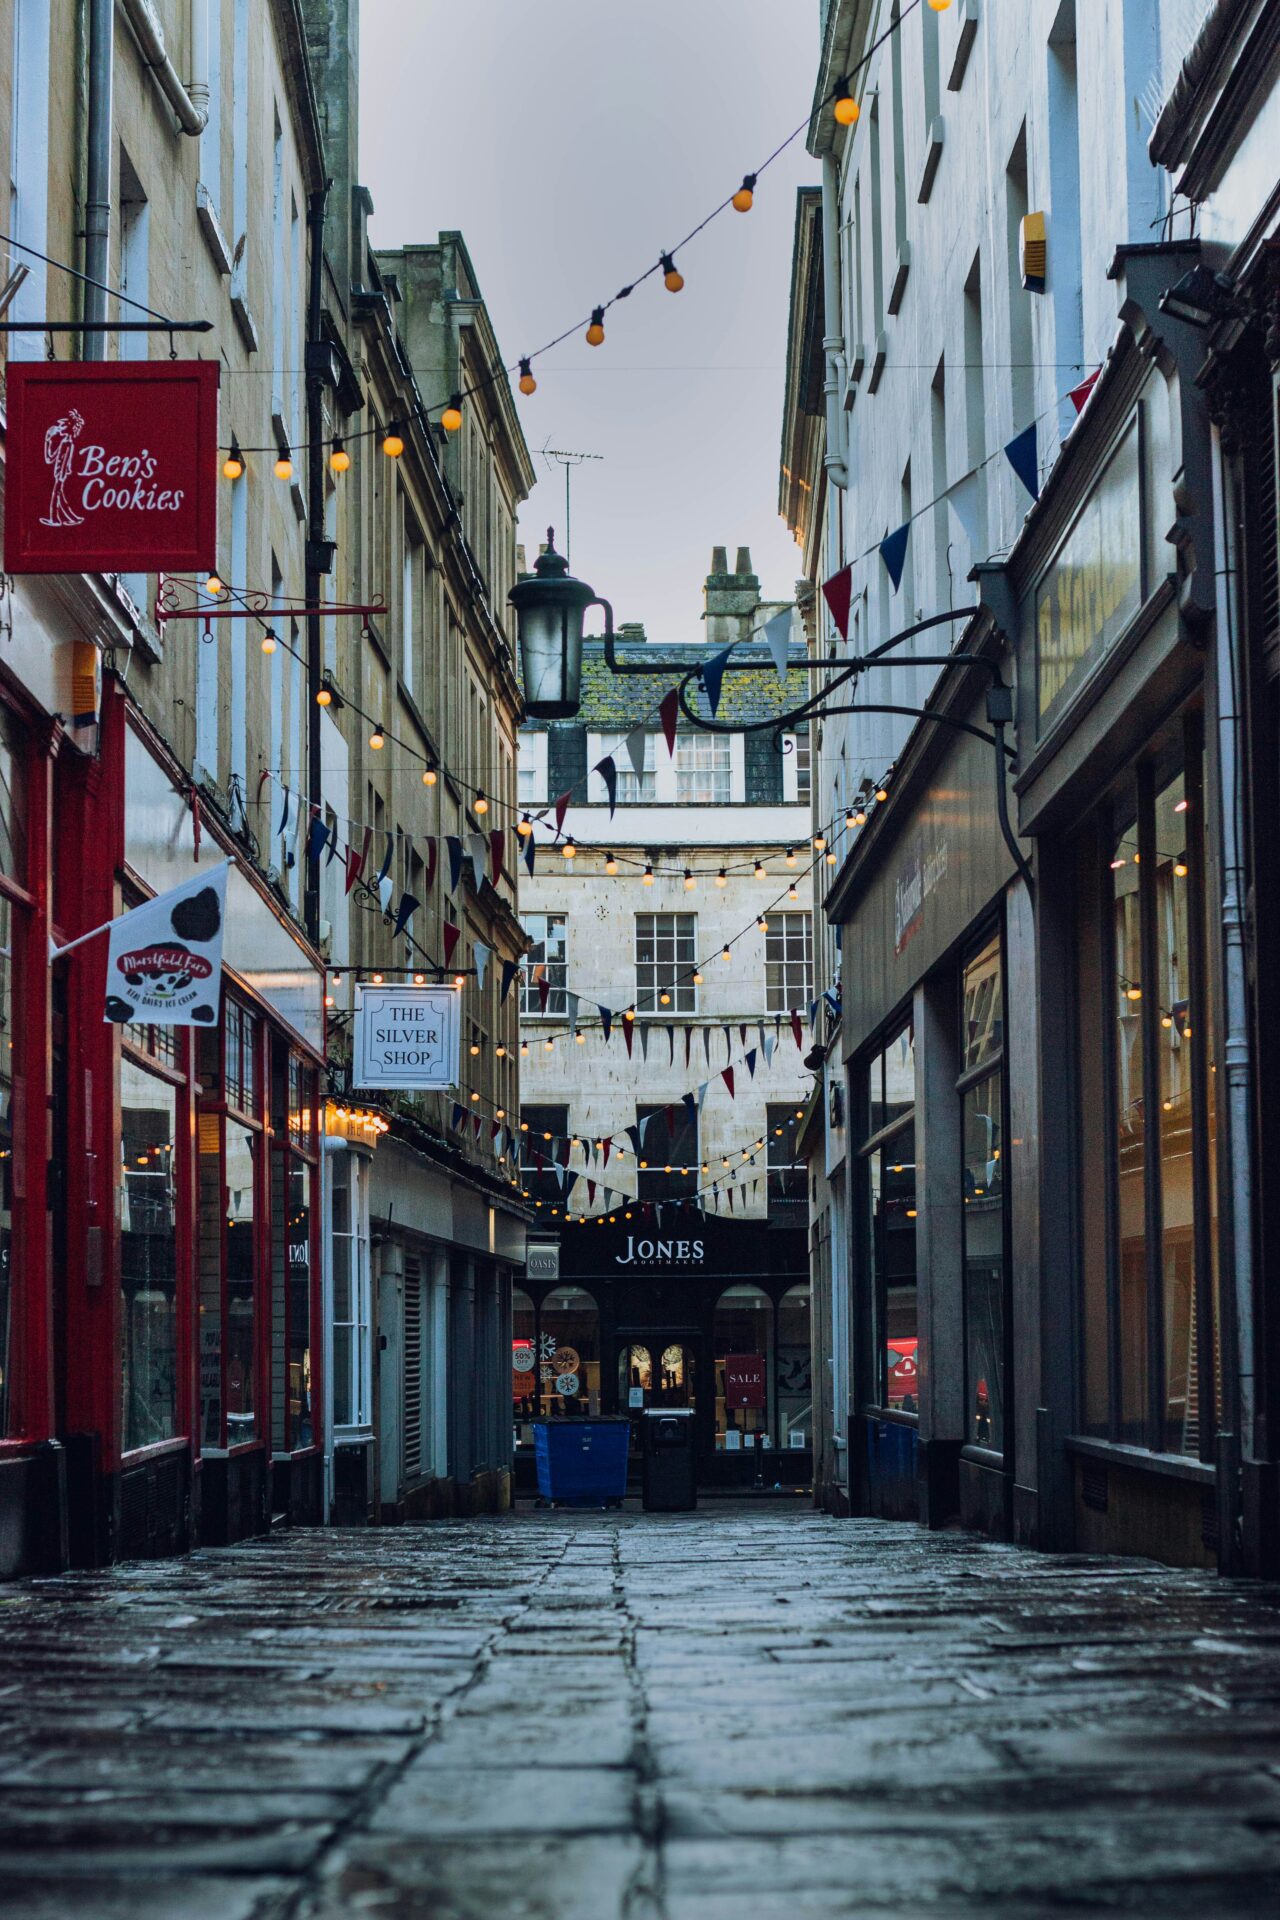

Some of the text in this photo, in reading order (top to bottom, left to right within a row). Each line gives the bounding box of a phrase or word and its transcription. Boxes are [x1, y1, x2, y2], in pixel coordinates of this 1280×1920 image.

[78, 445, 158, 478] Ben's
[82, 478, 185, 511] Cookies
[123, 952, 208, 974] Marshfield Farm
[126, 988, 140, 1001] REAL
[165, 999, 176, 1008] ICE
[178, 990, 198, 1006] CREAM
[389, 1007, 425, 1022] THE
[376, 1029, 438, 1043] SILVER
[383, 1051, 430, 1065] SHOP
[615, 1236, 704, 1264] JONES
[530, 1259, 556, 1269] OASIS
[515, 1352, 531, 1360] 50%
[729, 1373, 761, 1383] SALE
